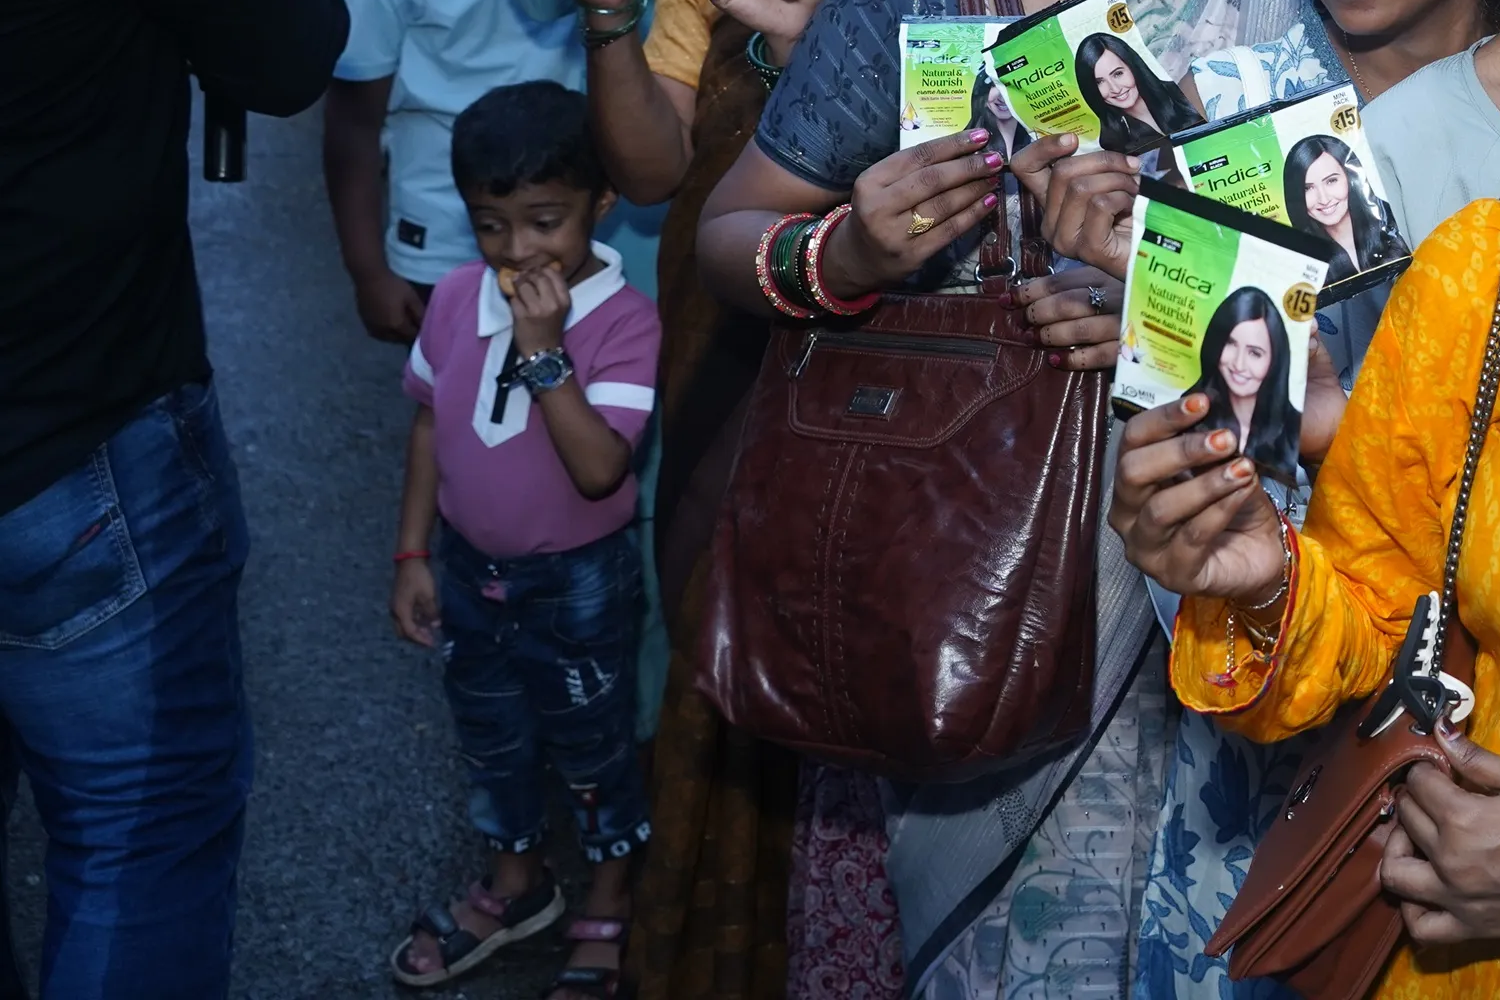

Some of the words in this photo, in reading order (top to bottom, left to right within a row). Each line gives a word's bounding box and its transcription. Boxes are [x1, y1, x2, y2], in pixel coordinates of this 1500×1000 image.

[1110, 5, 1130, 28] ₹15
[917, 53, 972, 65] Indica
[1006, 64, 1011, 72] 1
[921, 69, 955, 77] Natural
[956, 69, 963, 77] &
[921, 78, 963, 88] Nourish
[1012, 60, 1065, 91] Indica
[1025, 82, 1057, 102] Natural
[1056, 79, 1064, 88] &
[1029, 88, 1070, 111] Nourish
[1334, 106, 1356, 130] ₹15
[1208, 163, 1271, 192] Indica
[1219, 184, 1258, 204] Natural
[1258, 182, 1267, 191] &
[1261, 204, 1280, 215] color
[1156, 235, 1162, 245] 1
[1148, 256, 1212, 294] Indica
[1149, 283, 1188, 308] Natural
[1188, 299, 1195, 310] &
[1147, 296, 1193, 326] Nourish
[1138, 389, 1156, 400] MIN
